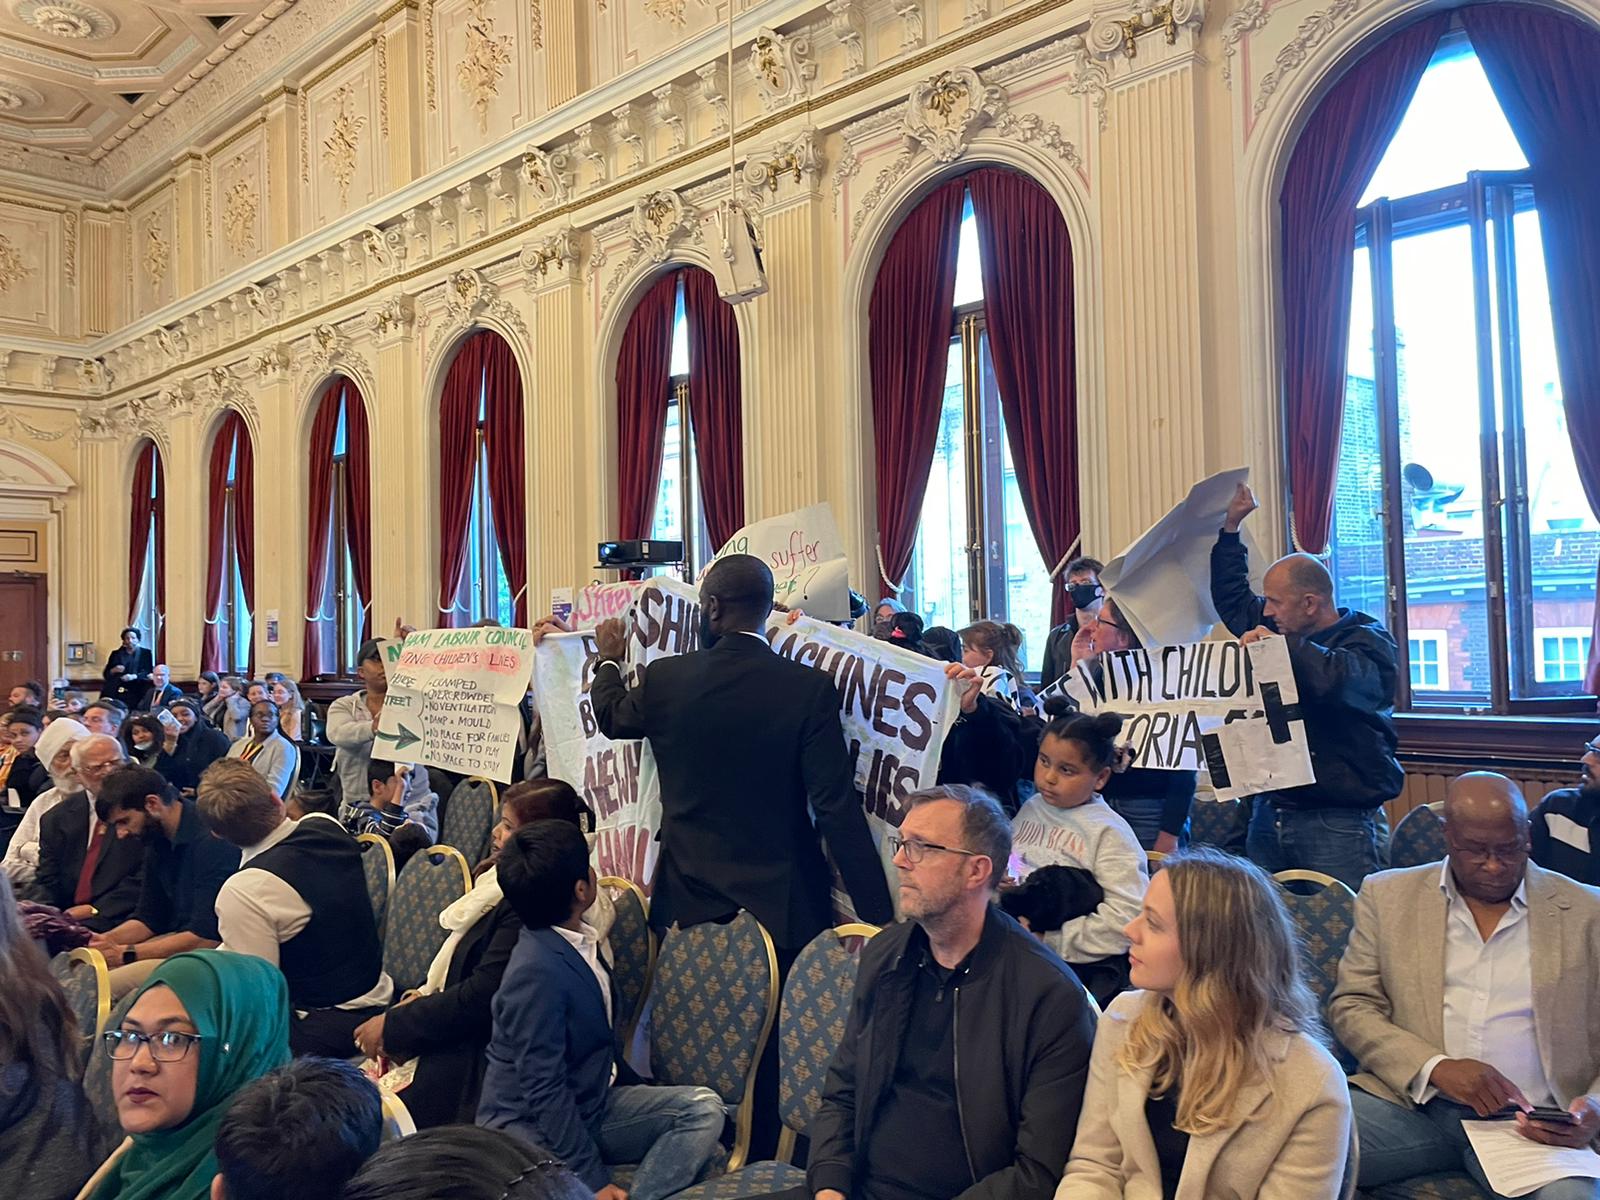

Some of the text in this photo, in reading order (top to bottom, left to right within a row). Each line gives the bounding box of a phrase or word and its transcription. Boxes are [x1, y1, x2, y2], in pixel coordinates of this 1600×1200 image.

[384, 694, 412, 708] TREET
[458, 716, 492, 729] MOULD
[467, 732, 487, 743] FOR
[467, 743, 484, 754] TO
[467, 758, 482, 769] TO
